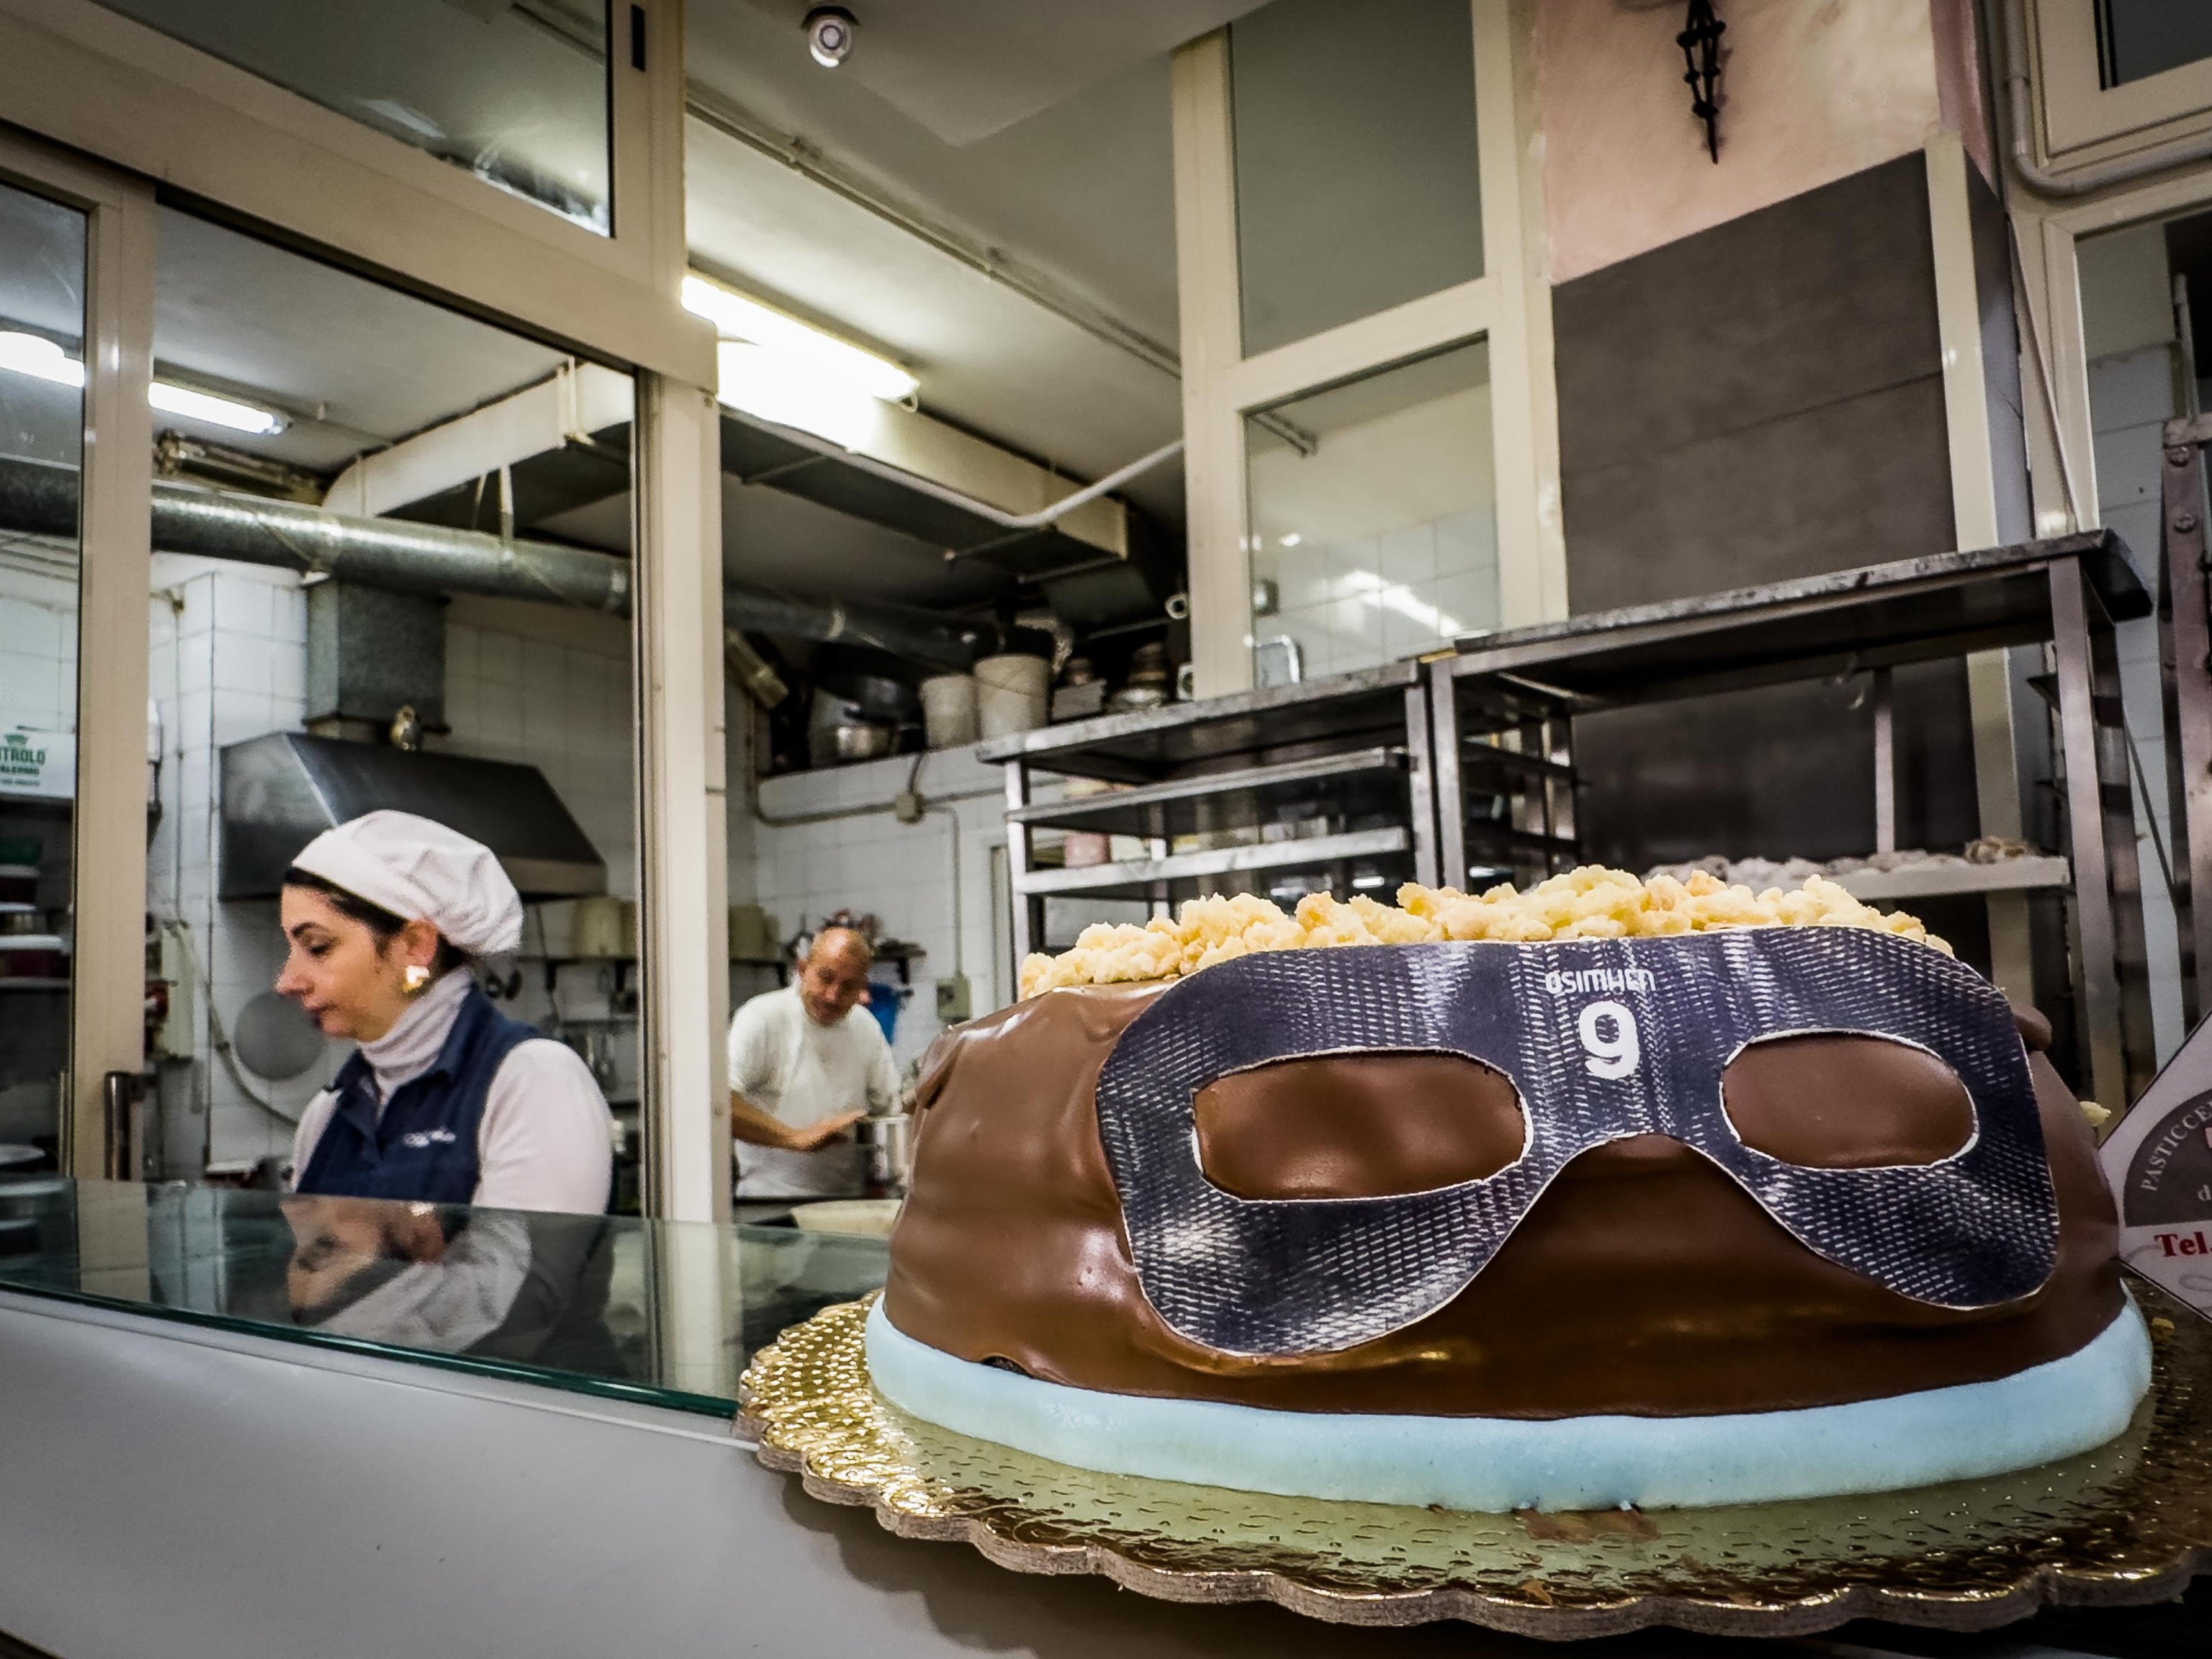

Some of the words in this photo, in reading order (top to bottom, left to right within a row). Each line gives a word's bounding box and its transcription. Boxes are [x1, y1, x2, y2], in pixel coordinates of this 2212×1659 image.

[0, 747, 46, 766] TROLO
[1578, 1000, 1640, 1079] 9
[2139, 1100, 2212, 1191] PASTICCE
